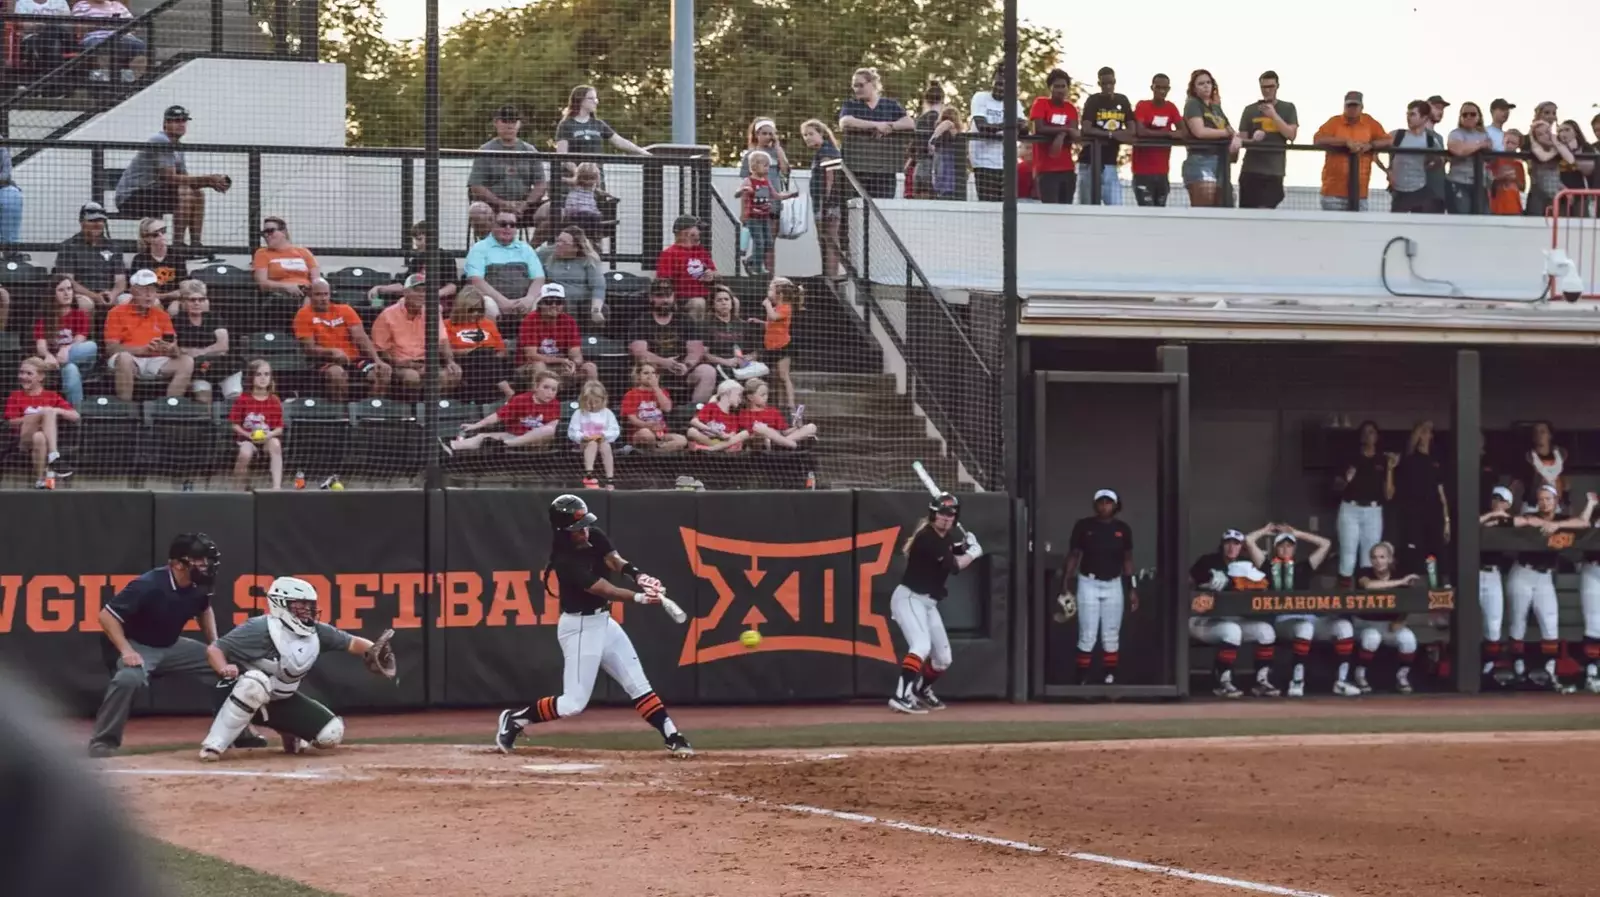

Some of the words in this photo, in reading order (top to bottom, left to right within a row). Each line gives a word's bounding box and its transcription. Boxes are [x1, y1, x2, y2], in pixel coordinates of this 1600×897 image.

[233, 570, 624, 632] SFTBA
[1251, 595, 1342, 611] OKLAHOMA
[1346, 594, 1396, 609] STATE
